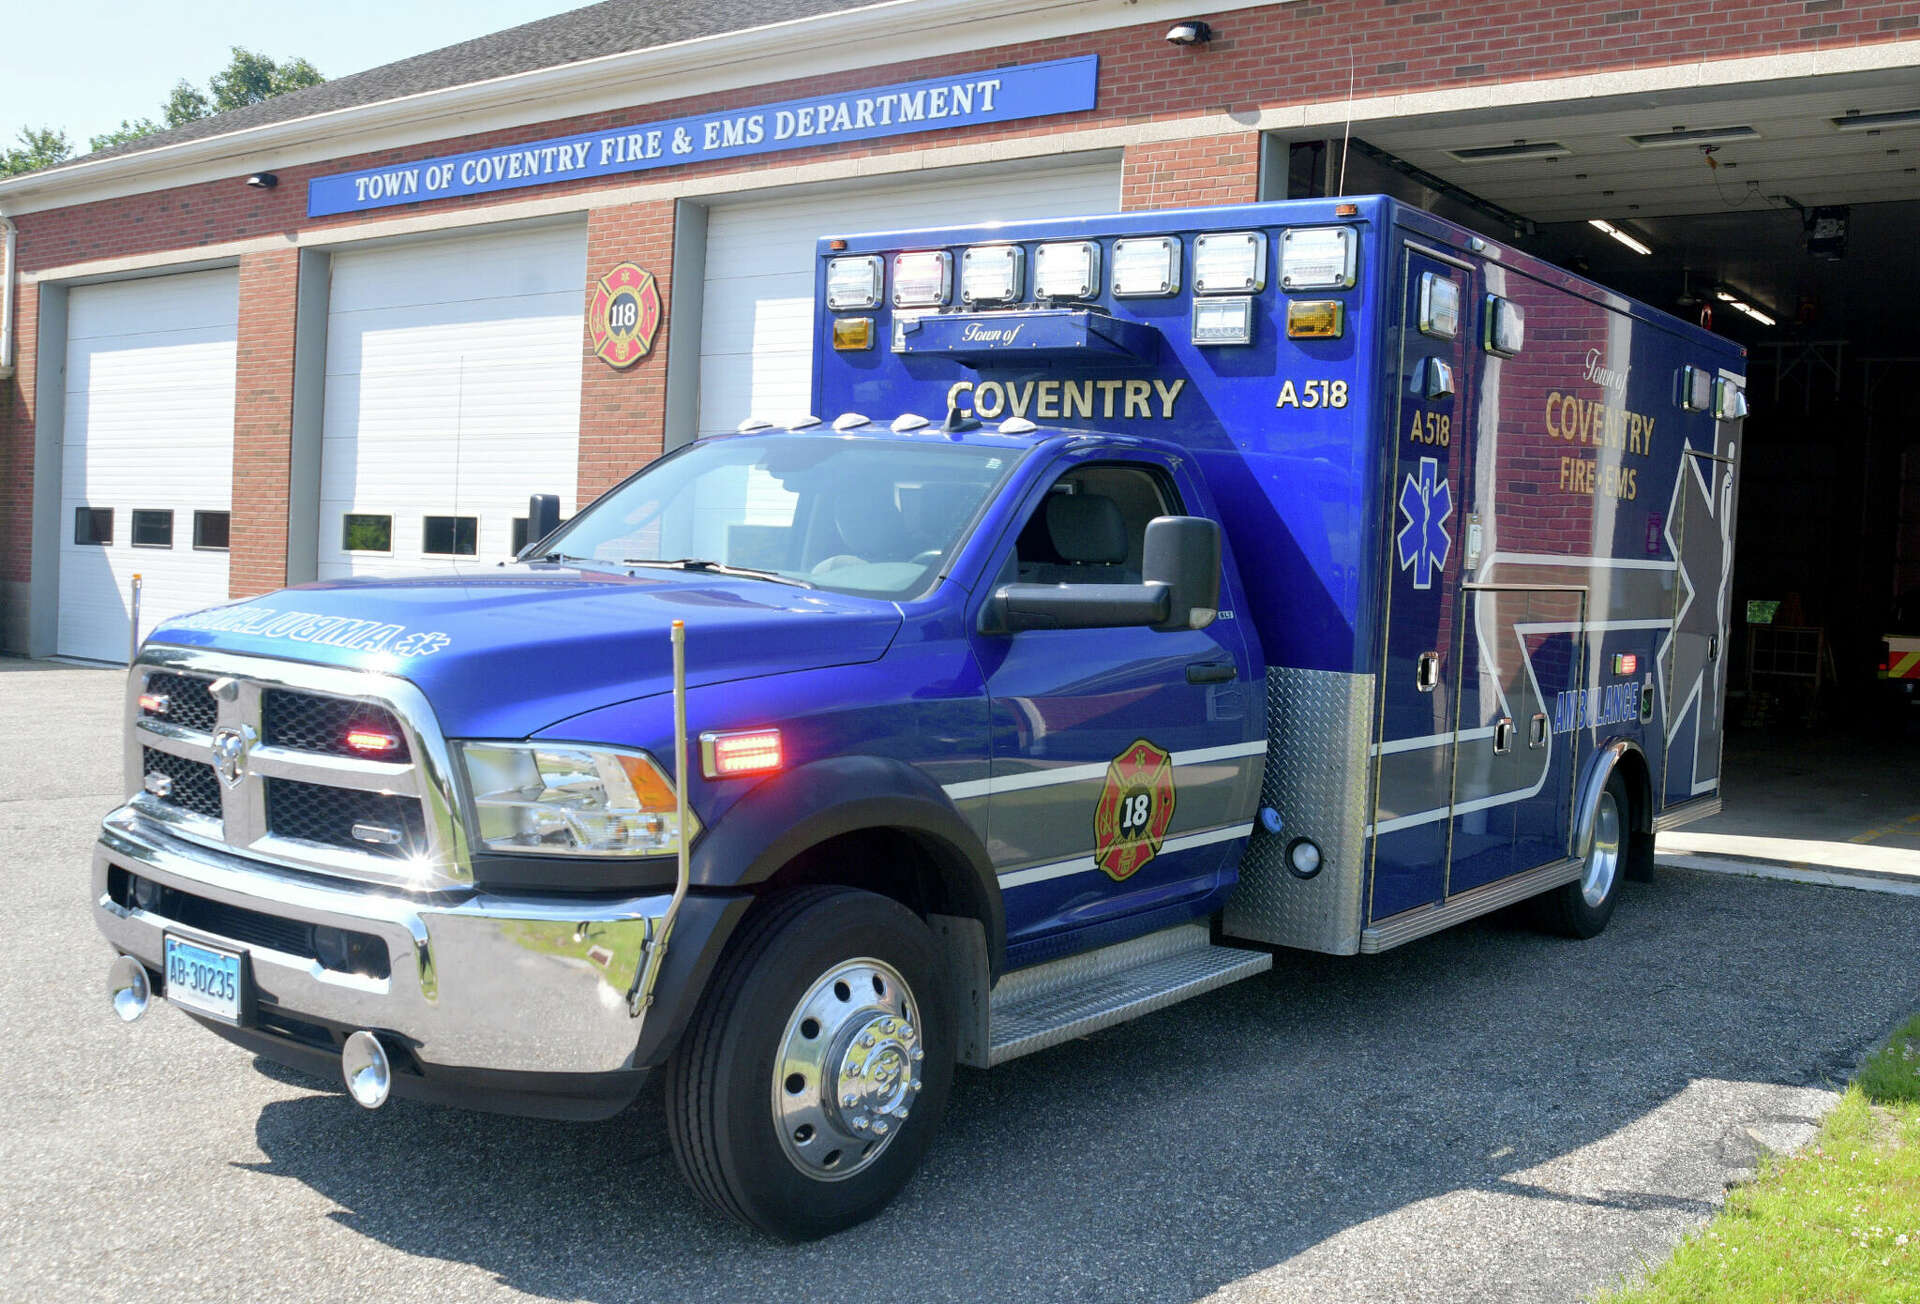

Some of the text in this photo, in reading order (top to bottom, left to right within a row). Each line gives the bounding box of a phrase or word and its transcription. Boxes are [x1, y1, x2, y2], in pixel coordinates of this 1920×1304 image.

[355, 79, 1001, 201] TOWN OF COVENTRY FIRE & EMS DEPARTMENT
[611, 303, 636, 327] 118
[962, 323, 1024, 345] Town of
[1583, 348, 1632, 398] Town of
[947, 379, 1186, 419] COVENTRY
[1276, 380, 1348, 409] A518
[1410, 409, 1450, 447] A518
[1545, 391, 1656, 456] COVENTRY
[1560, 456, 1638, 501] FIRE EMS
[1553, 682, 1639, 734] AMBULANCE
[1123, 794, 1149, 828] 18
